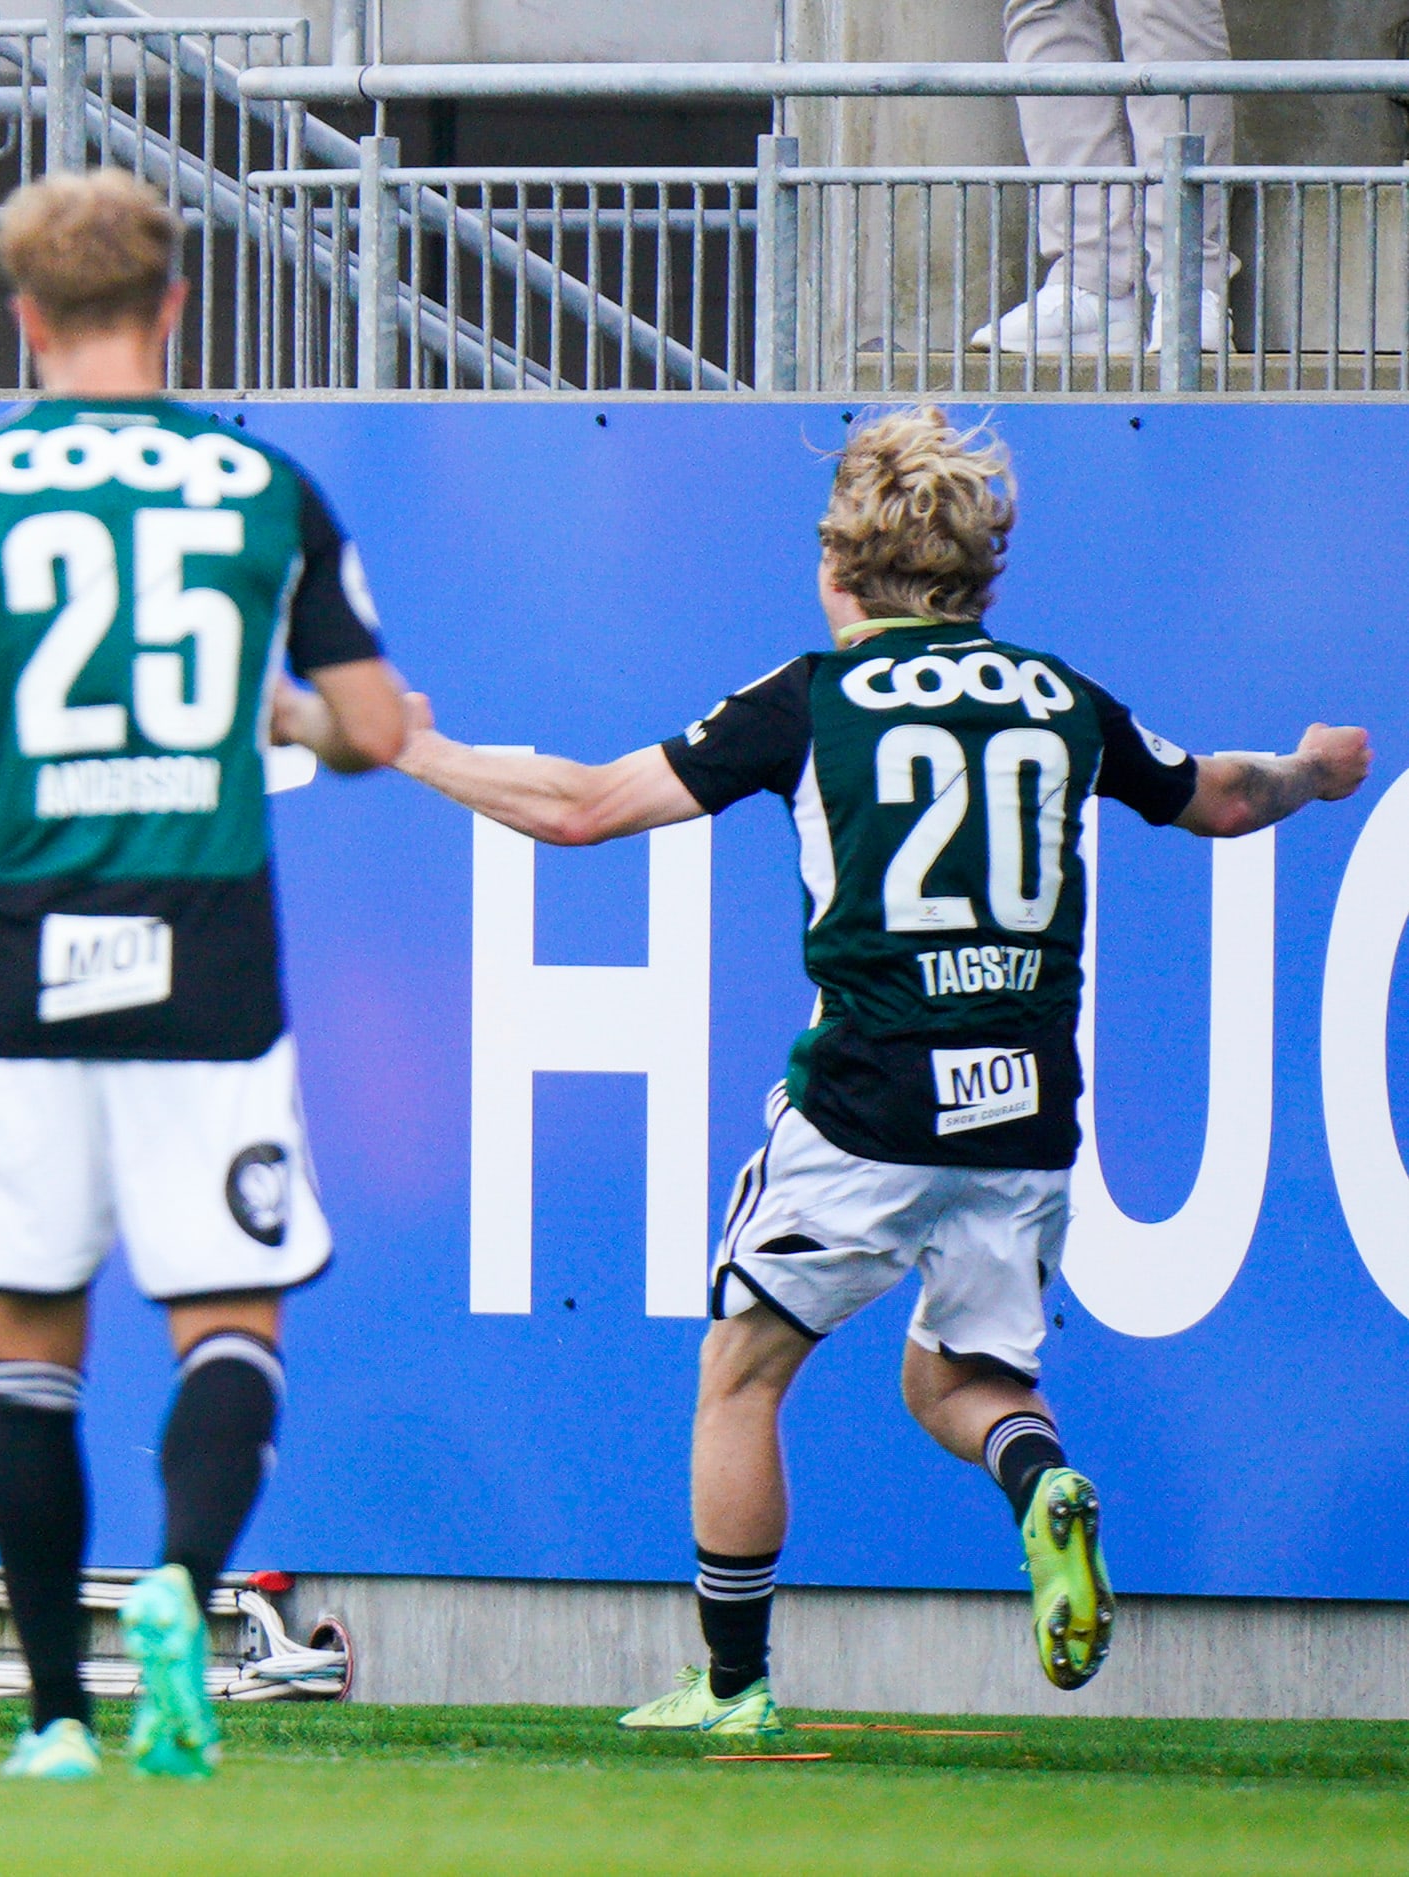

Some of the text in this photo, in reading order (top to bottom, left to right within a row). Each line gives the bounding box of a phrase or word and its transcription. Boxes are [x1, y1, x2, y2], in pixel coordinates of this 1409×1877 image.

[1, 510, 246, 758] 25
[841, 652, 1074, 720] coop
[876, 724, 1071, 932] 20
[950, 1050, 1033, 1103] MOT
